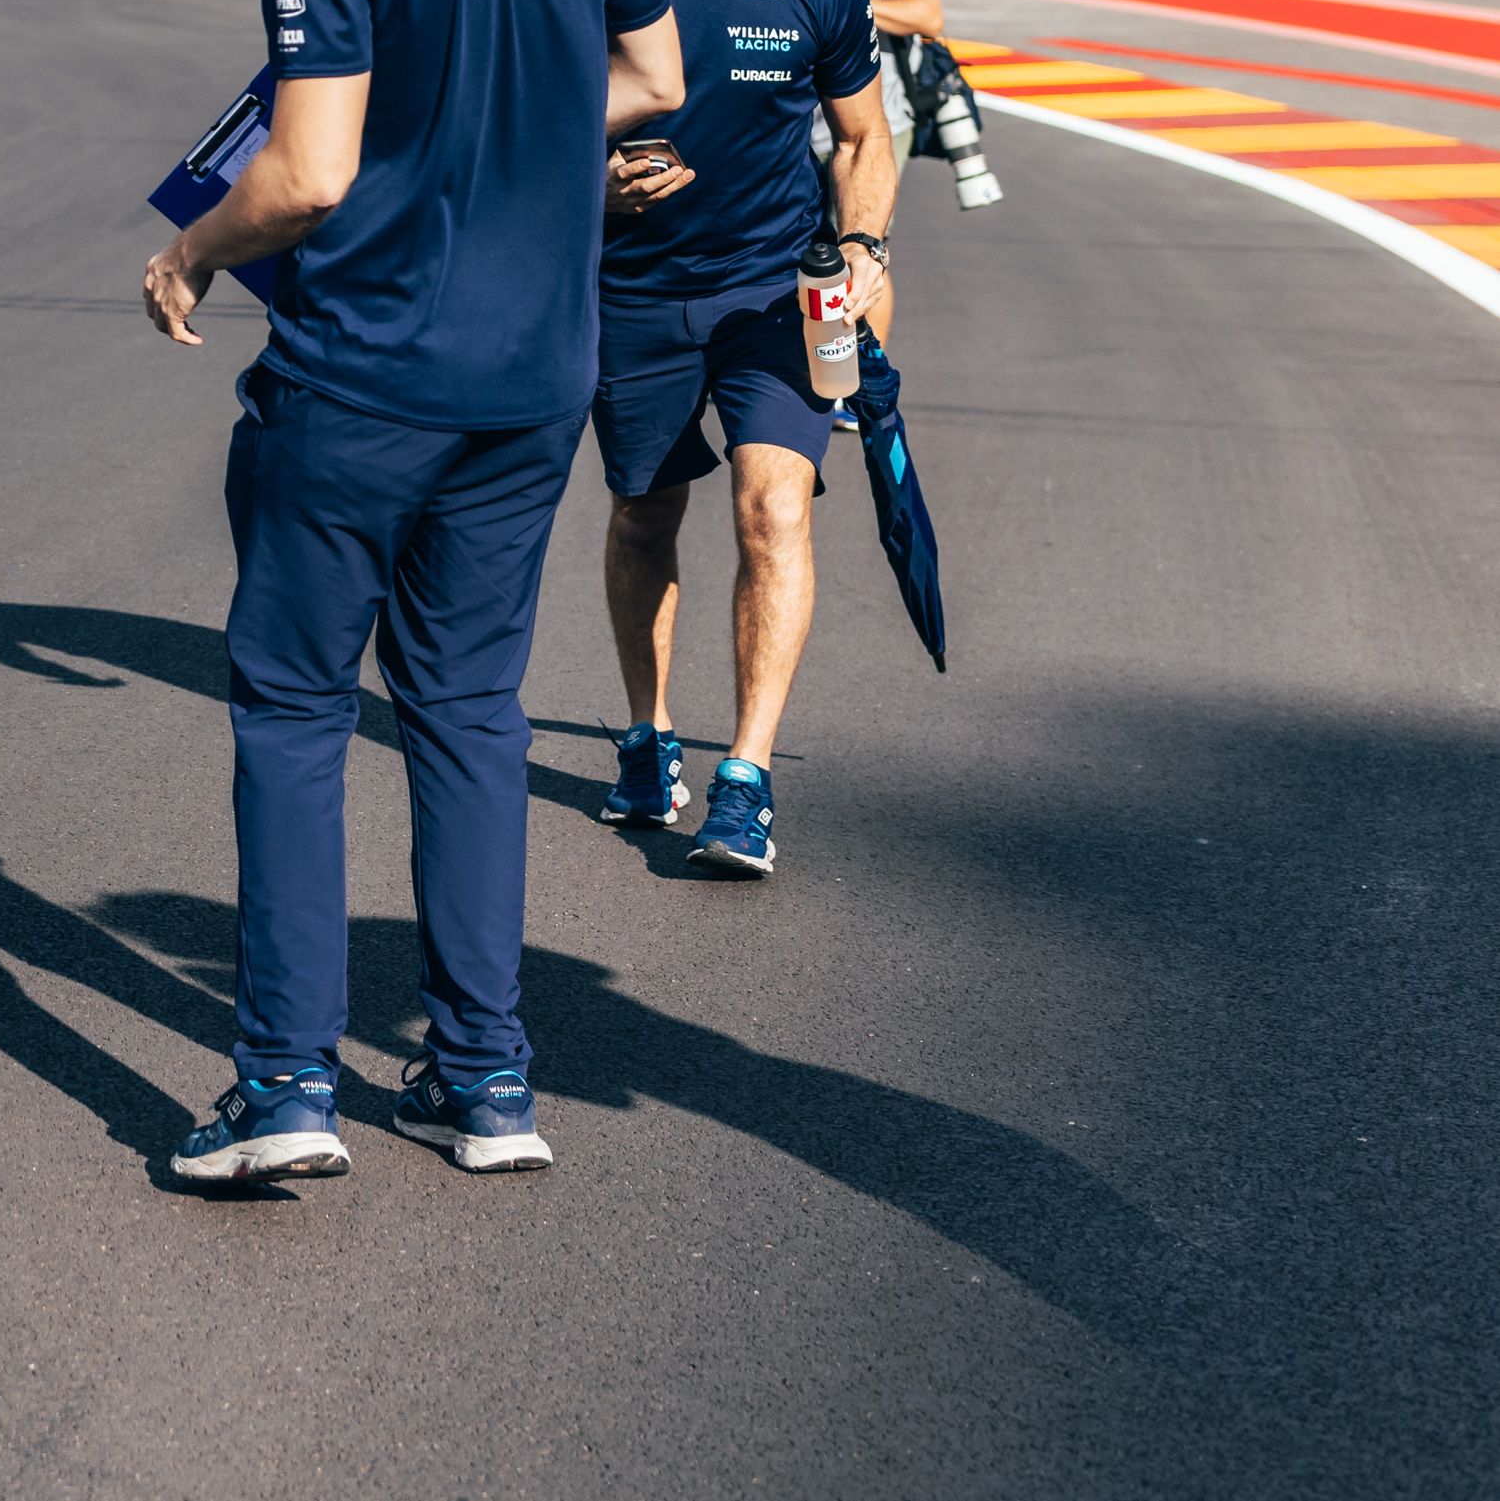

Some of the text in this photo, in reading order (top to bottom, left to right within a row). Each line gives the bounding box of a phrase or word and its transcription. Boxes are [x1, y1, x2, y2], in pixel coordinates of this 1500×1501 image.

[727, 27, 800, 41] WILLIAMS
[735, 38, 791, 51] RACING
[731, 69, 792, 82] DURACELL
[819, 340, 856, 357] SOFINA
[299, 1081, 334, 1093] WILLIAMS
[489, 1085, 526, 1094] WILLIAMS
